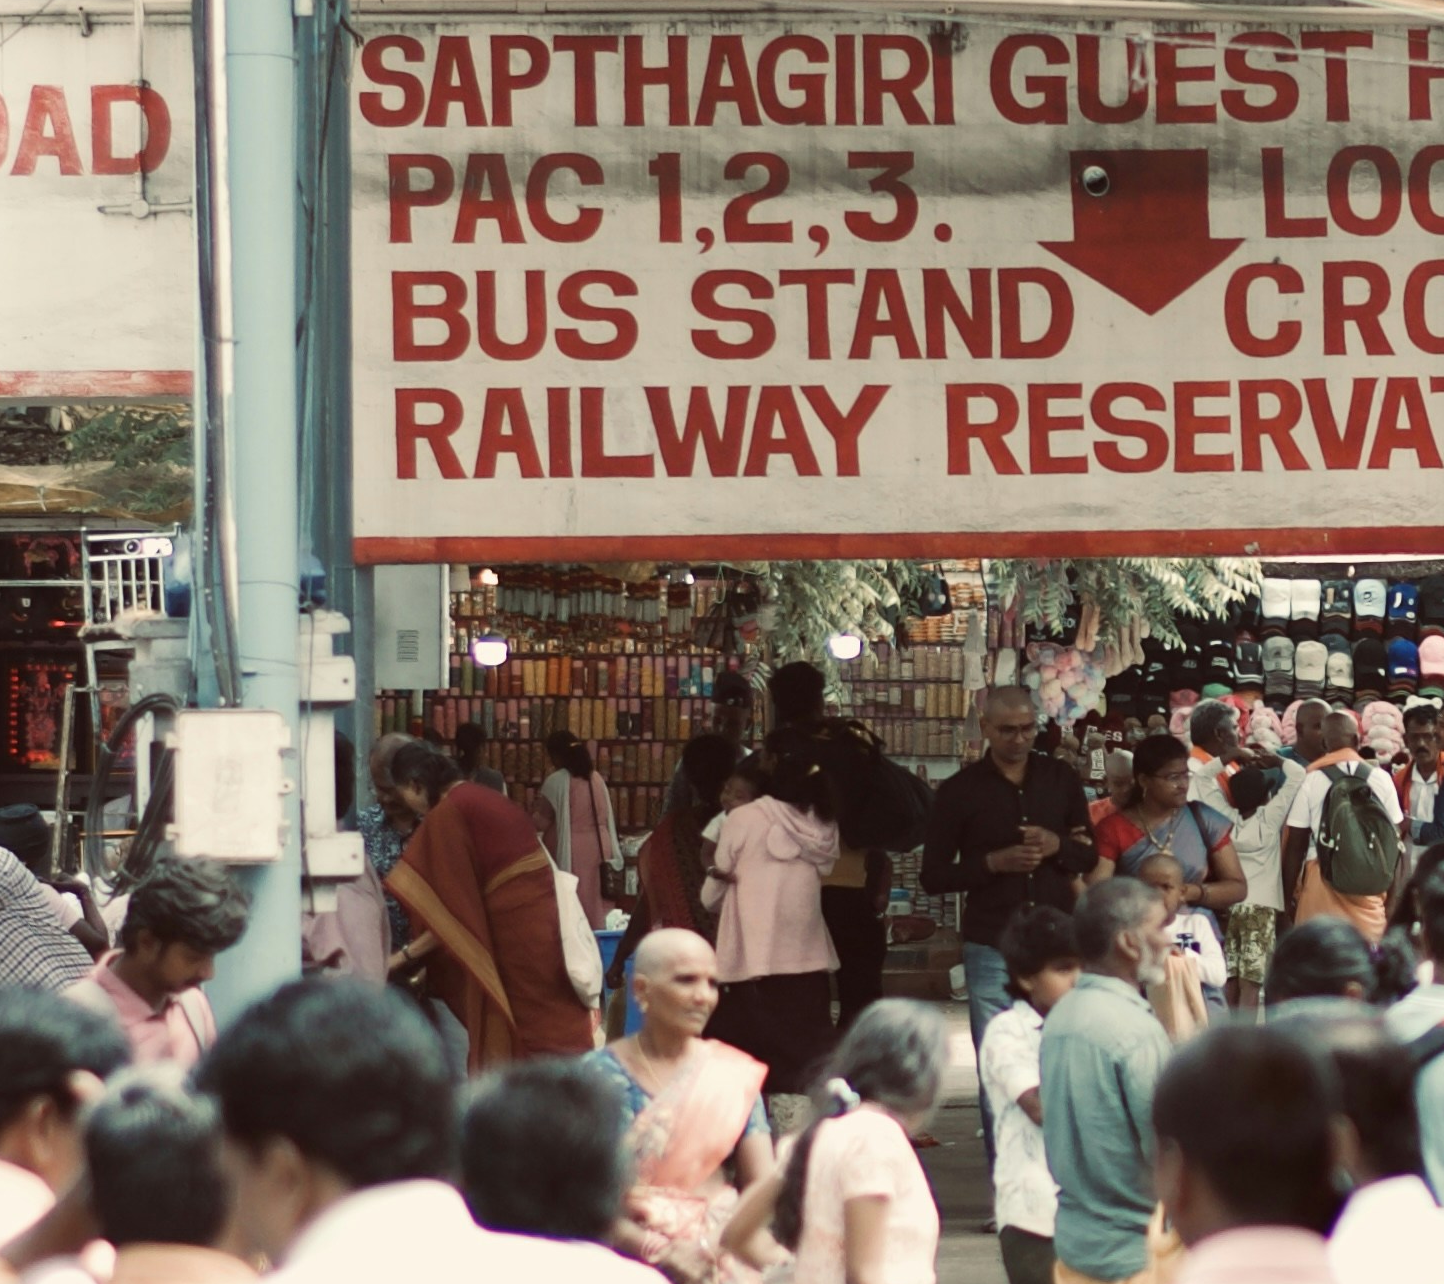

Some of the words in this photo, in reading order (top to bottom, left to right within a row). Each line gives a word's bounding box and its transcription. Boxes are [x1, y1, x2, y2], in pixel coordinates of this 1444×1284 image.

[359, 35, 953, 128] SAPTHAGIRI
[990, 32, 1372, 125] GUEST
[388, 152, 604, 244] PAC
[649, 151, 953, 255] 1,2,3.
[391, 269, 638, 363] BUS
[690, 266, 1074, 361] STAND
[395, 384, 890, 480] RAILWAY
